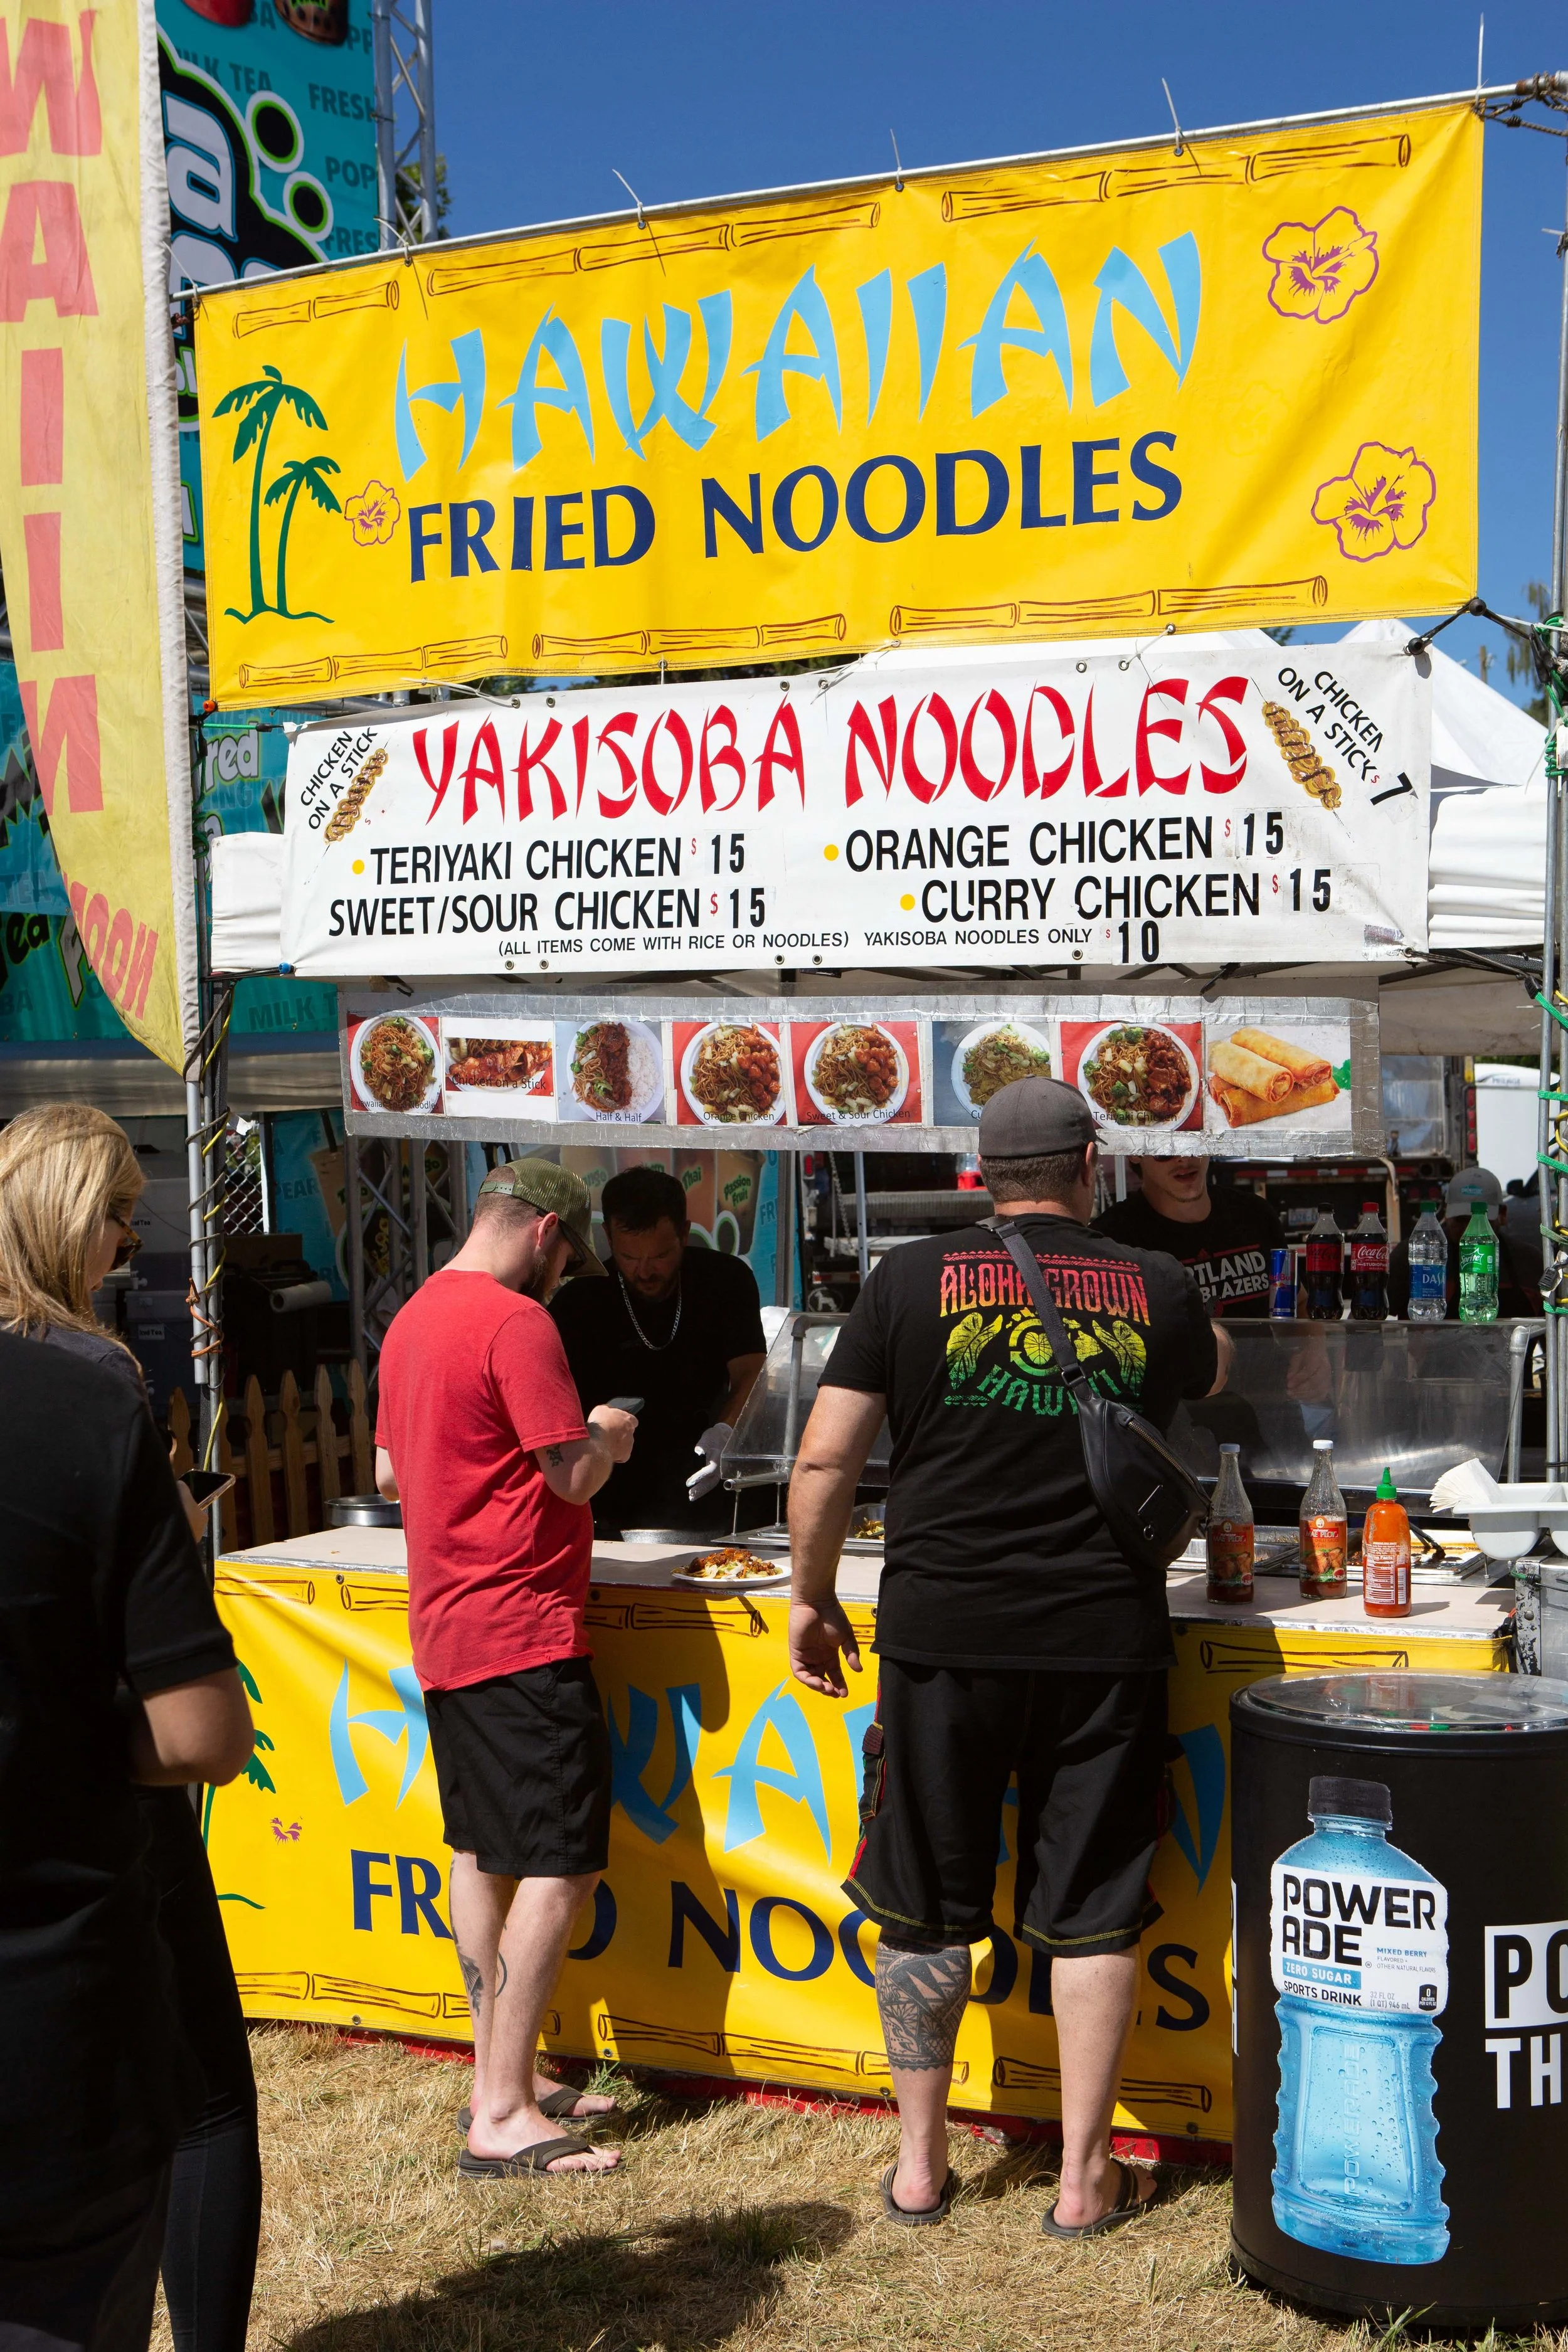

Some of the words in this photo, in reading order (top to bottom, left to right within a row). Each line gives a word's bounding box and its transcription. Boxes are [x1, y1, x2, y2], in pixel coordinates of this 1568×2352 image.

[395, 230, 1201, 482] HAWAIIAN
[408, 485, 655, 583] FRIED
[702, 431, 1182, 558] NOODLES
[1278, 667, 1311, 702] ON
[1305, 704, 1326, 724] A
[1323, 723, 1377, 781] STICK
[1315, 671, 1383, 753] CHICKEN
[300, 731, 353, 806] CHICKEN
[413, 694, 805, 825] YAKISOBA
[845, 676, 1249, 808] NOODLES
[309, 800, 331, 830] ON
[329, 783, 345, 799] A
[341, 727, 378, 778] STICK
[370, 842, 512, 885] TERIYAKI
[526, 837, 681, 881] CHICKEN
[845, 825, 1009, 872] ORANGE
[1029, 817, 1212, 866] CHICKEN
[329, 893, 538, 936] SWEET/SOUR
[555, 888, 700, 931] CHICKEN
[921, 878, 1056, 923] CURRY
[1074, 873, 1259, 921] CHICKEN
[499, 941, 531, 956] (ALL
[538, 939, 583, 953] ITEMS
[590, 938, 635, 952] COME
[644, 936, 681, 950] WITH
[689, 935, 724, 949] RICE
[733, 934, 755, 948] OR
[763, 931, 849, 948] NOODLES)
[864, 932, 947, 946] YAKISOBA
[955, 930, 1039, 945] NOODLES
[1048, 928, 1092, 943] ONLY
[452, 1073, 492, 1087] Chicken
[495, 1078, 509, 1088] on
[512, 1080, 519, 1089] a
[521, 1078, 546, 1090] Stick
[595, 1111, 613, 1121] Half
[615, 1113, 623, 1121] &
[625, 1112, 642, 1123] Half
[703, 1111, 738, 1123] Orange
[739, 1111, 775, 1122] Chicken
[807, 1111, 837, 1121] Sweet
[838, 1111, 846, 1120] &
[848, 1110, 871, 1120] Sour
[872, 1108, 911, 1119] Chicken
[1093, 1111, 1135, 1124] Teriyaki
[1136, 1111, 1178, 1123] Chicken
[682, 1167, 702, 1191] Thai
[1461, 1253, 1480, 1264] Sprite
[1044, 1268, 1151, 1327] GROWN
[1283, 1873, 1436, 1931] POWER
[1282, 1915, 1362, 1966] ADE
[1284, 1980, 1318, 1998] SPORTS
[1322, 1989, 1362, 2006] DRINK
[1285, 1961, 1308, 1976] ZERO
[1311, 1968, 1352, 1985] SUGAR
[1426, 1988, 1431, 1997] 0
[1389, 2001, 1400, 2009] 946
[1485, 2033, 1562, 2109] TH
[1343, 2043, 1364, 2197] POWERADE
